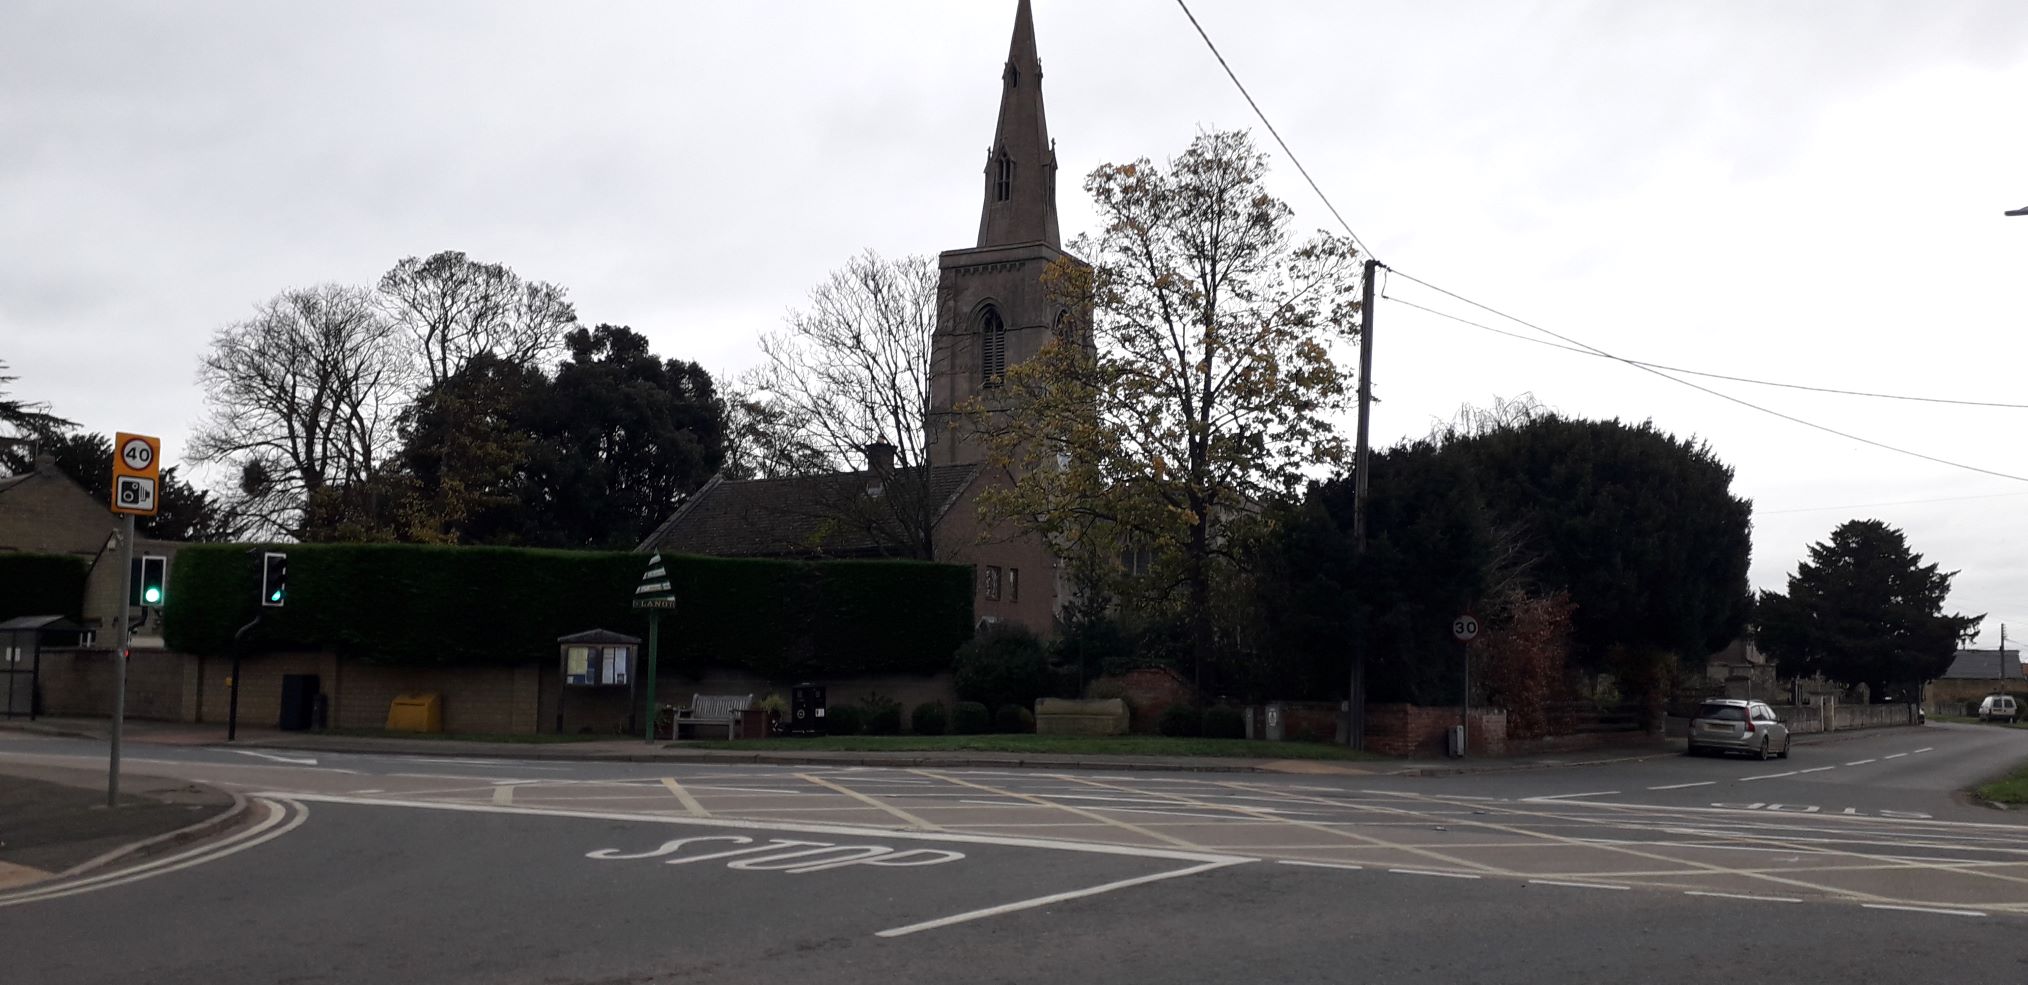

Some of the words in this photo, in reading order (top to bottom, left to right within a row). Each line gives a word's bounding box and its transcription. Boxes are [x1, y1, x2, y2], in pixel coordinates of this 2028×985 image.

[125, 447, 150, 462] 40
[1455, 621, 1476, 634] 30
[585, 835, 966, 874] STOP
